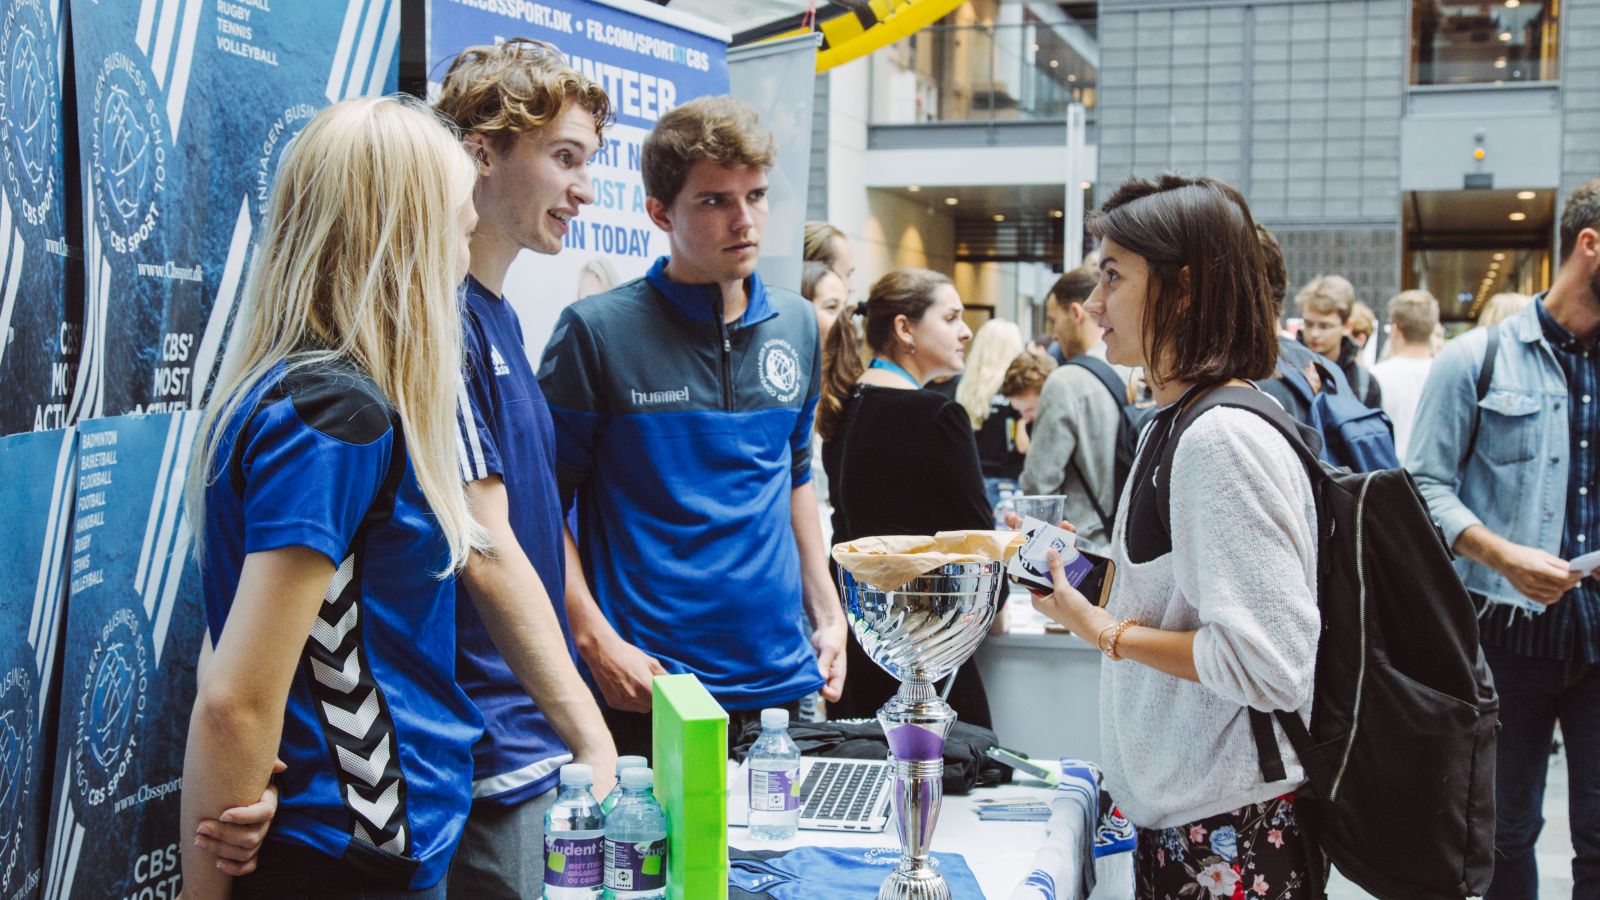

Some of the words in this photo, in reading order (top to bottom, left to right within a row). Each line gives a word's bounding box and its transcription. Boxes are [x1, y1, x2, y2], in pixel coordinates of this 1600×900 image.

[217, 0, 251, 21] RUGBY
[448, 0, 573, 34] .CBSSPORT.DK
[216, 17, 253, 40] TENNIS
[216, 35, 279, 66] VOLLEYBALL
[104, 52, 147, 96] BUSINESS
[146, 98, 166, 193] SCHOOL
[258, 117, 285, 215] ENHAGEN
[22, 198, 38, 226] CBS
[38, 165, 55, 224] SPORT
[591, 177, 626, 211] OST
[110, 230, 127, 254] CBS
[127, 201, 159, 252] SPORT
[591, 222, 650, 257] TODAY
[154, 367, 190, 397] MOST
[631, 386, 689, 404] hummel
[81, 450, 117, 471] BASKETBALL
[134, 633, 147, 724] SCHOOL
[88, 786, 106, 806] CBS
[107, 734, 137, 796] SPORT
[114, 777, 183, 814] www.Cbssport
